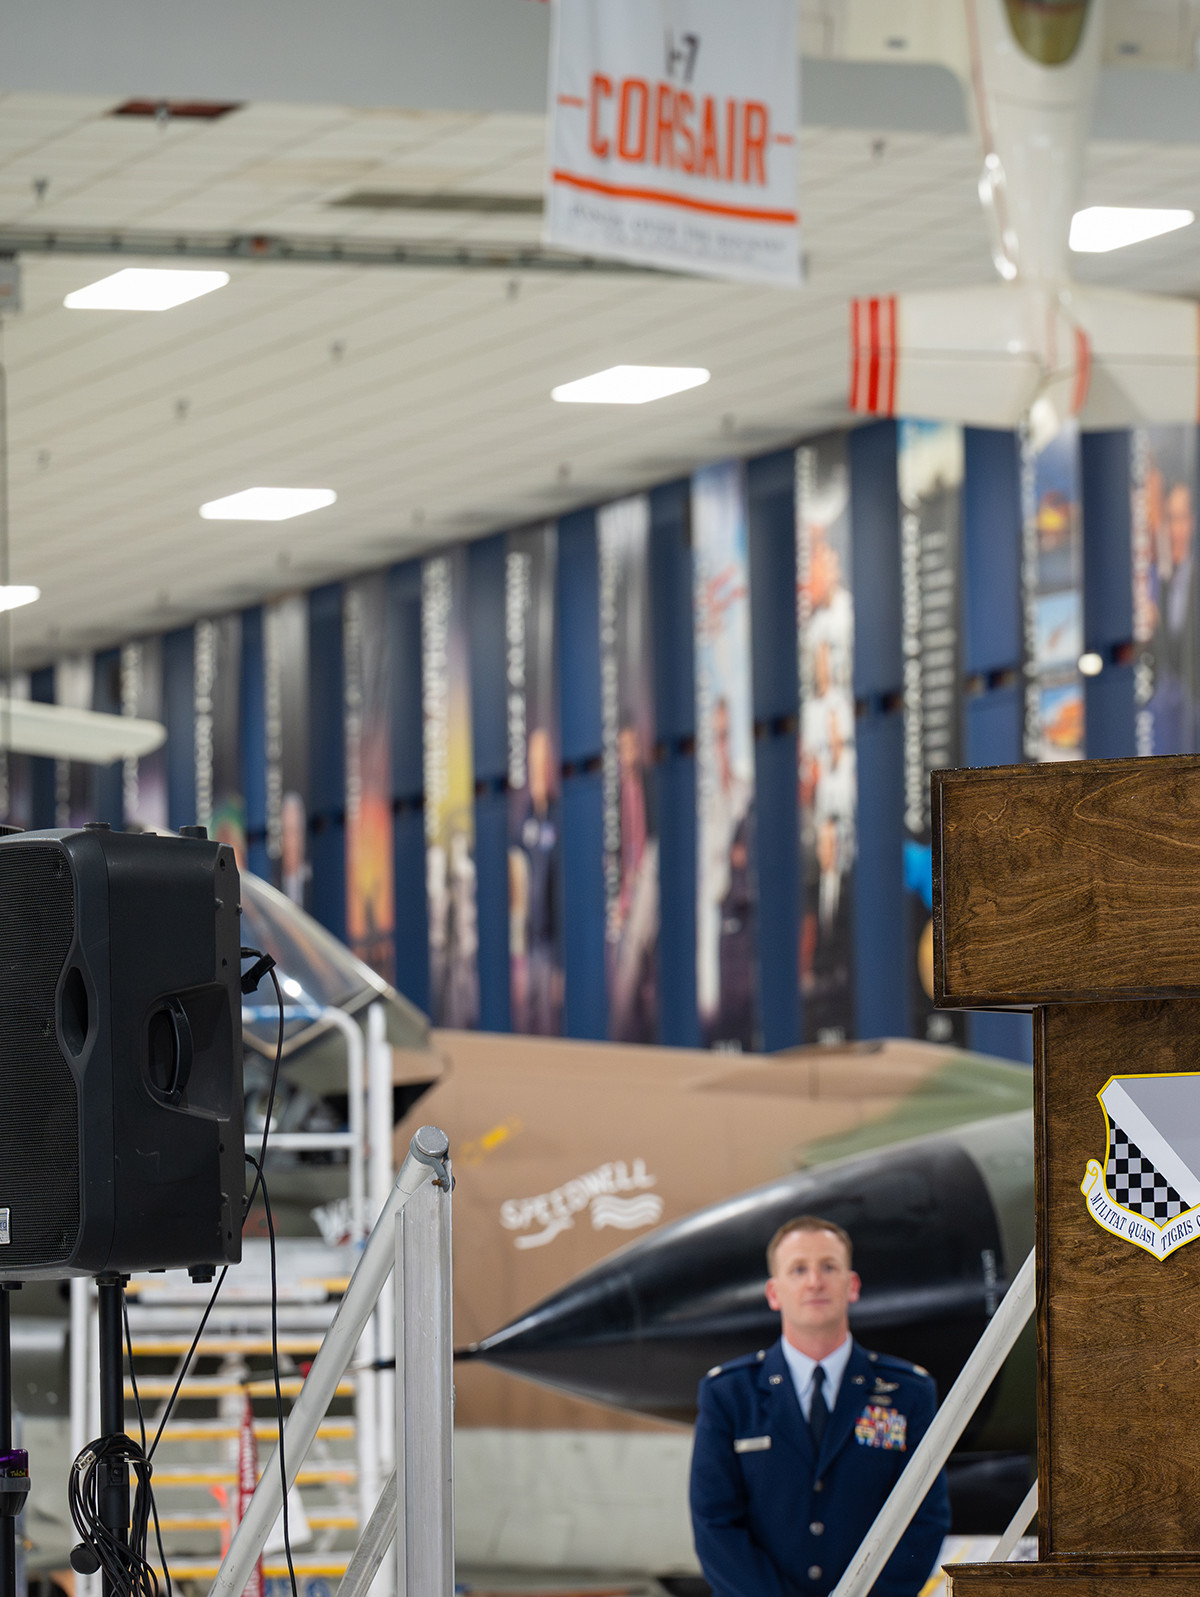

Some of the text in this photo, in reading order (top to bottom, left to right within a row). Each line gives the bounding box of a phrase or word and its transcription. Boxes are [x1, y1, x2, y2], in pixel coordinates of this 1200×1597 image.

[1090, 1192, 1127, 1231] MILITAT
[1128, 1220, 1155, 1247] QUASI
[1161, 1219, 1194, 1252] TIGRIS
